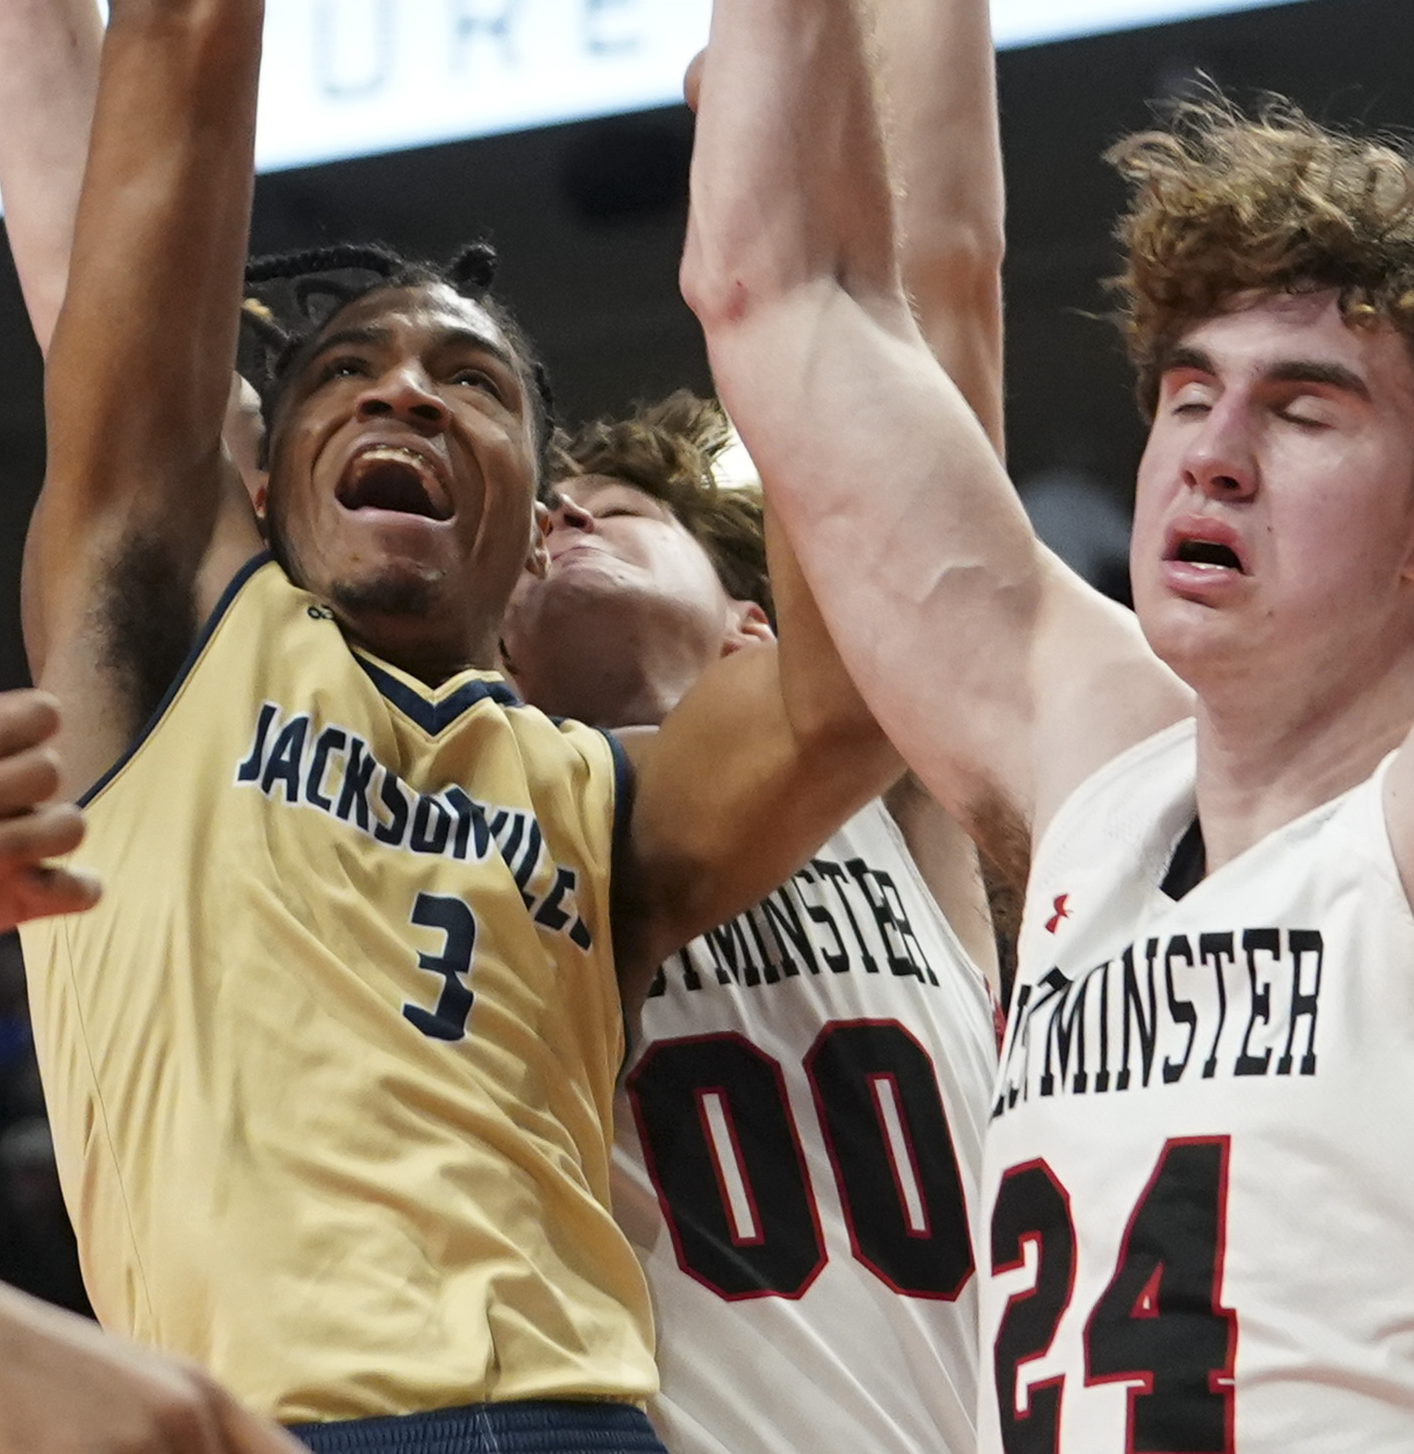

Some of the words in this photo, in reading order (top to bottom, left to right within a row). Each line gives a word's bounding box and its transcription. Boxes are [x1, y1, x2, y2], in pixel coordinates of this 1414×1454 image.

[401, 891, 477, 1042] 3
[625, 1017, 977, 1303] 00
[990, 1133, 1238, 1454] 24
